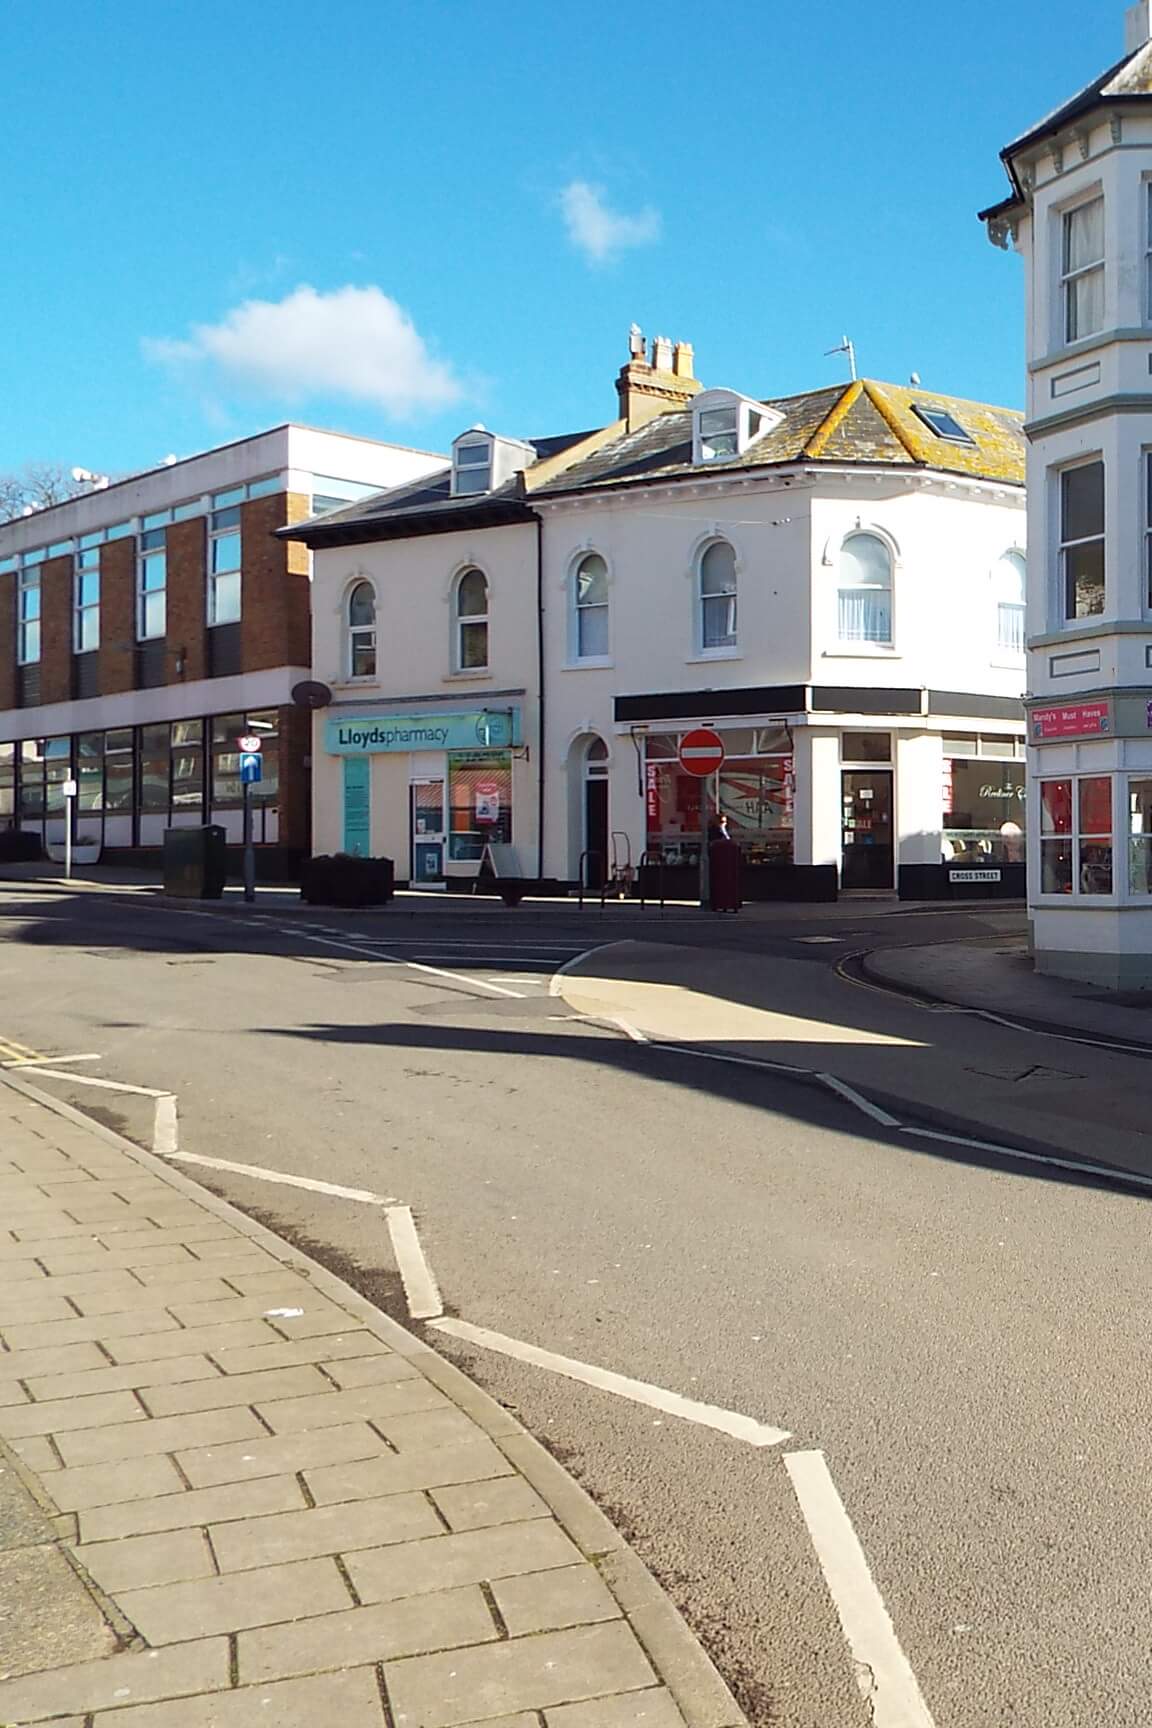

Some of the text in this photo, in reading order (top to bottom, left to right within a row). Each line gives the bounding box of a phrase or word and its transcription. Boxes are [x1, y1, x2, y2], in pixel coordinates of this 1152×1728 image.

[1062, 712, 1077, 721] Must
[338, 727, 449, 748] Lloydspharmacy
[647, 764, 657, 816] SALE
[783, 759, 793, 812] SALE
[952, 871, 998, 880] CROSS STREET
